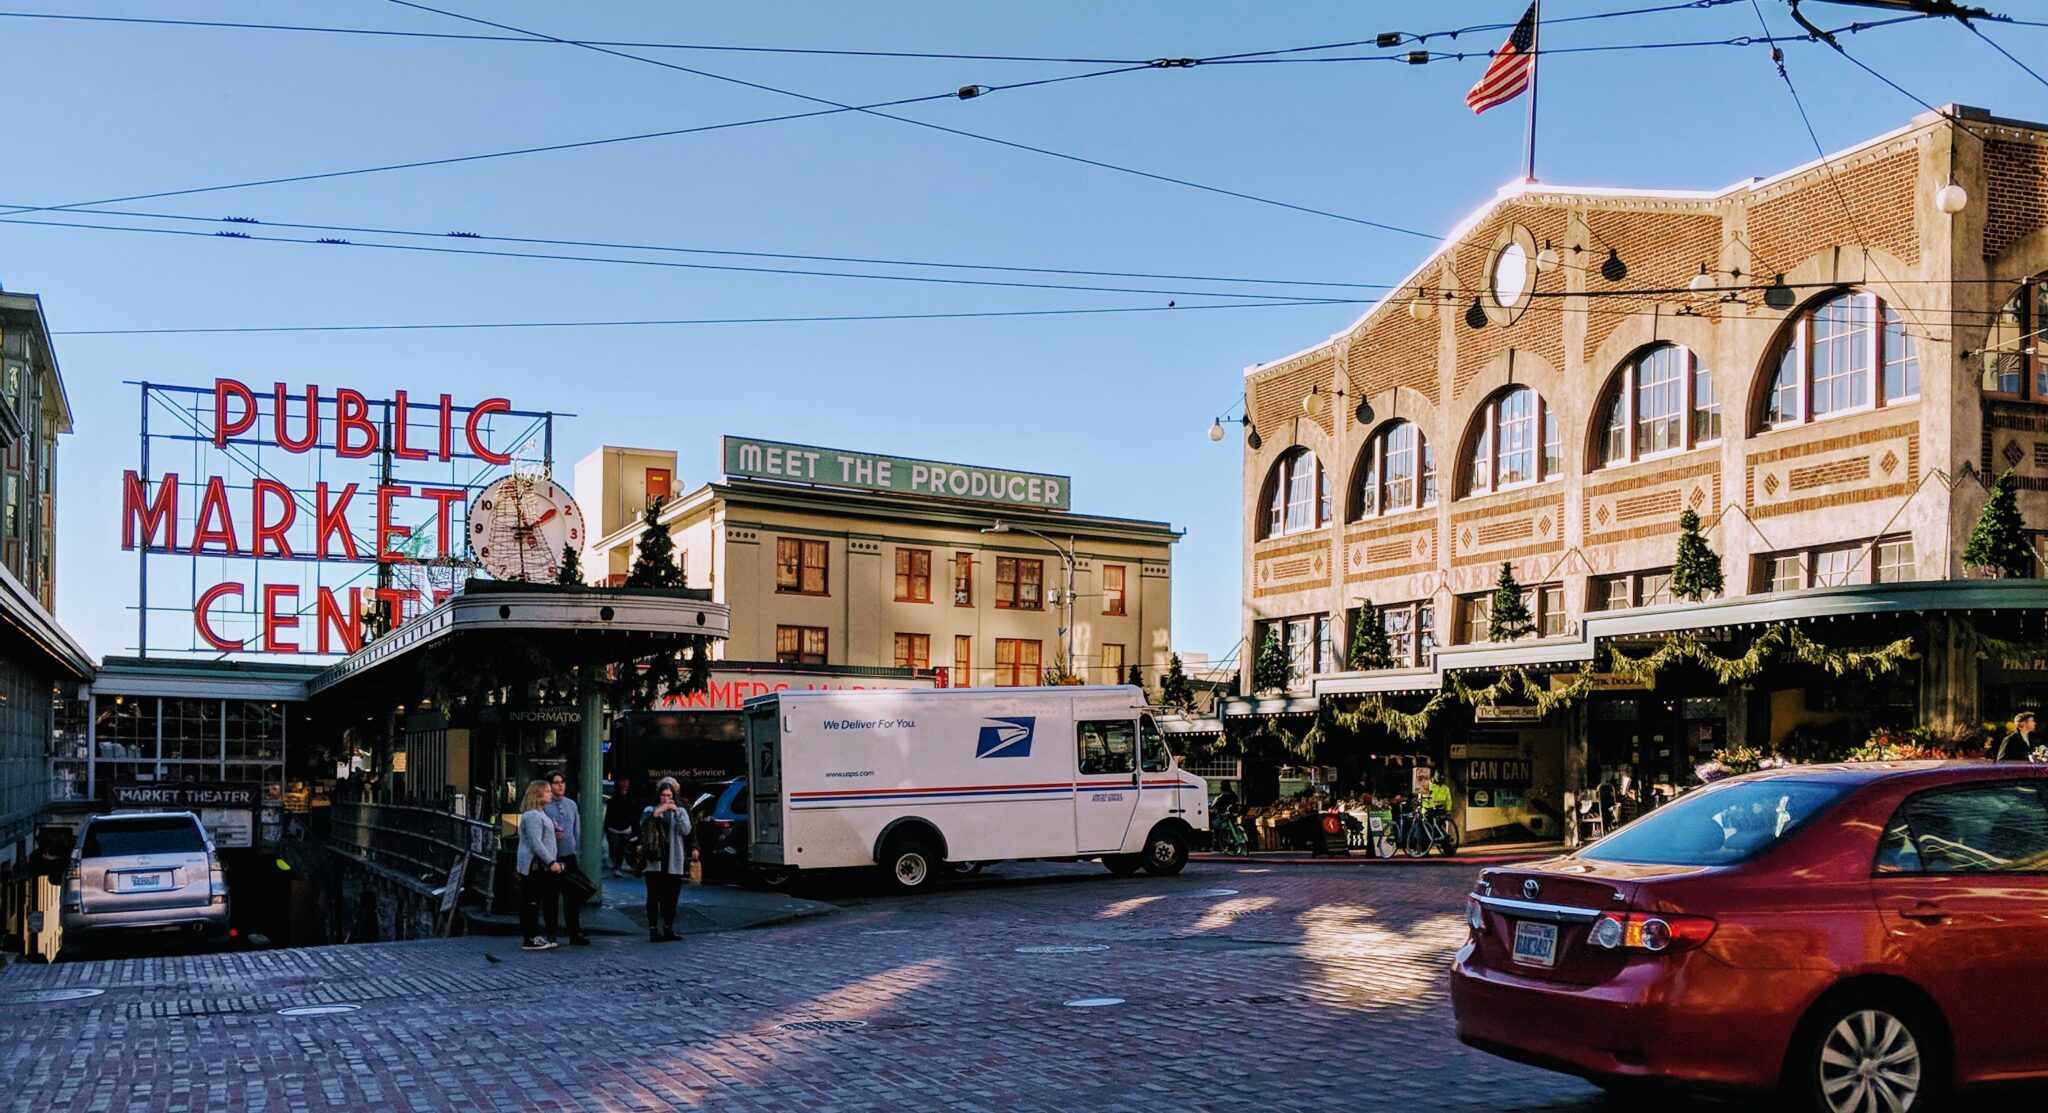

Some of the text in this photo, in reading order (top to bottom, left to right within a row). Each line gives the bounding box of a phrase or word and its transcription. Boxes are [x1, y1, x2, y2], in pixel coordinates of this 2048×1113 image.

[214, 378, 511, 465] PUBLIC
[739, 444, 1060, 503] MEET THE PRODUCER
[481, 500, 492, 511] 10
[564, 505, 572, 516] 2
[121, 469, 468, 564] MARKET
[475, 523, 484, 534] 9
[570, 529, 578, 539] 3
[481, 547, 490, 558] 8
[194, 582, 455, 656] CENT
[823, 719, 916, 729] We Deliver For You.
[648, 768, 726, 777] Worldwide Services
[825, 770, 875, 778] www.usps.com
[1470, 760, 1529, 780] CAN CAN
[119, 789, 250, 803] MARKET THEATER
